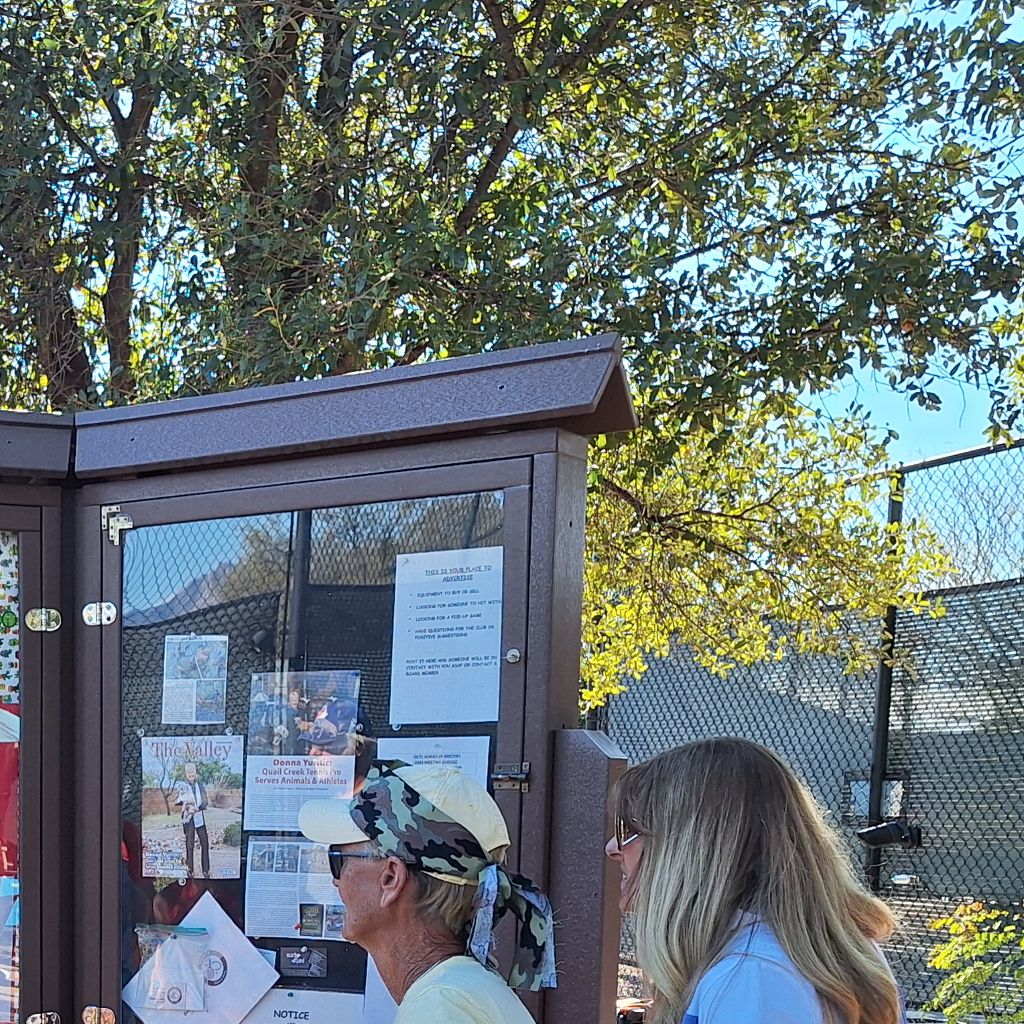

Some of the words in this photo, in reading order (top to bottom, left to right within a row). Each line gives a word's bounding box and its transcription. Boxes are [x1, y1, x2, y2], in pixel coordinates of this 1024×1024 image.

[442, 574, 473, 582] ADVERTISE
[152, 742, 181, 757] The
[184, 741, 232, 760] Valley
[262, 768, 282, 776] Quail
[274, 1010, 310, 1020] NOTICE
